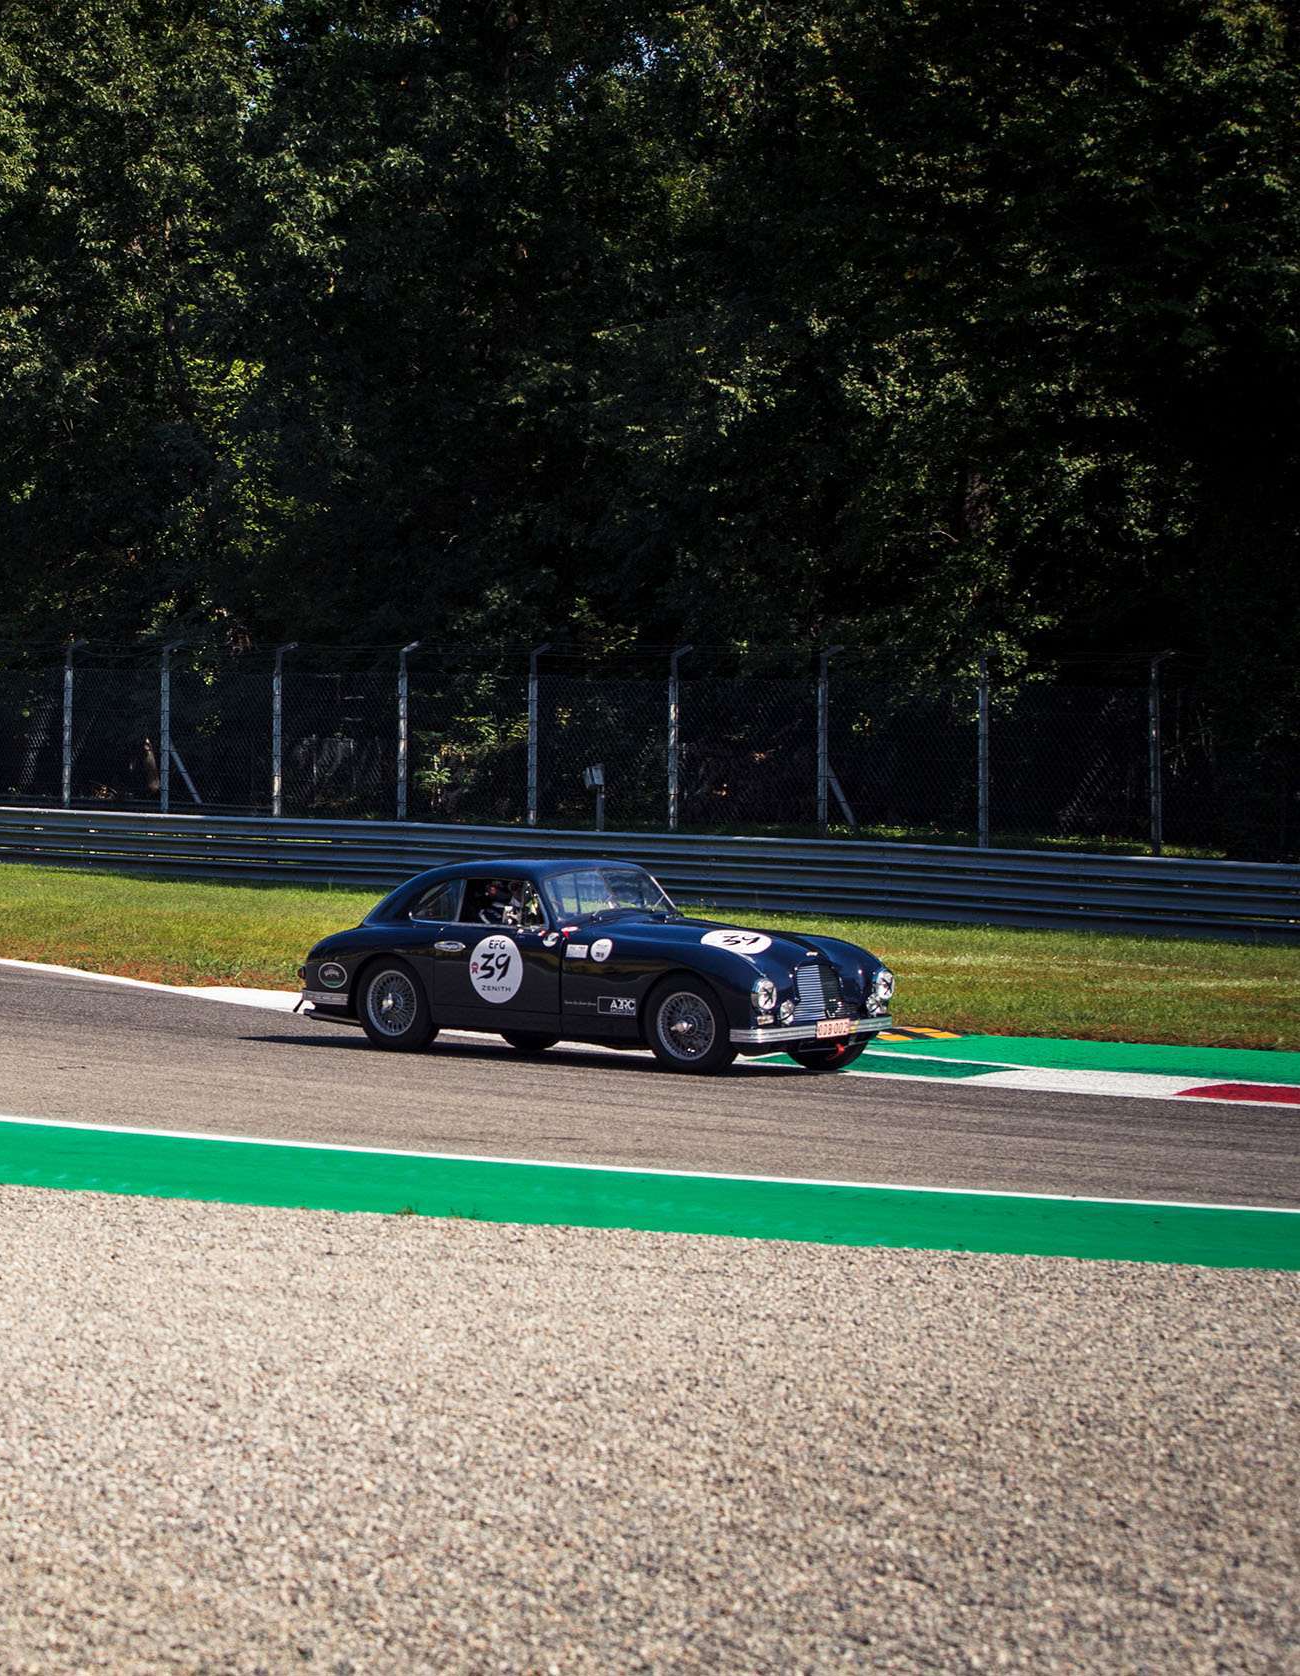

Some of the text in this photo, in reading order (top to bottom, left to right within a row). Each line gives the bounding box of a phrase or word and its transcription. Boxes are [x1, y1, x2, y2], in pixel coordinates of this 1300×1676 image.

[488, 939, 506, 950] EFG
[476, 952, 511, 982] 39
[481, 984, 512, 993] ZENITH
